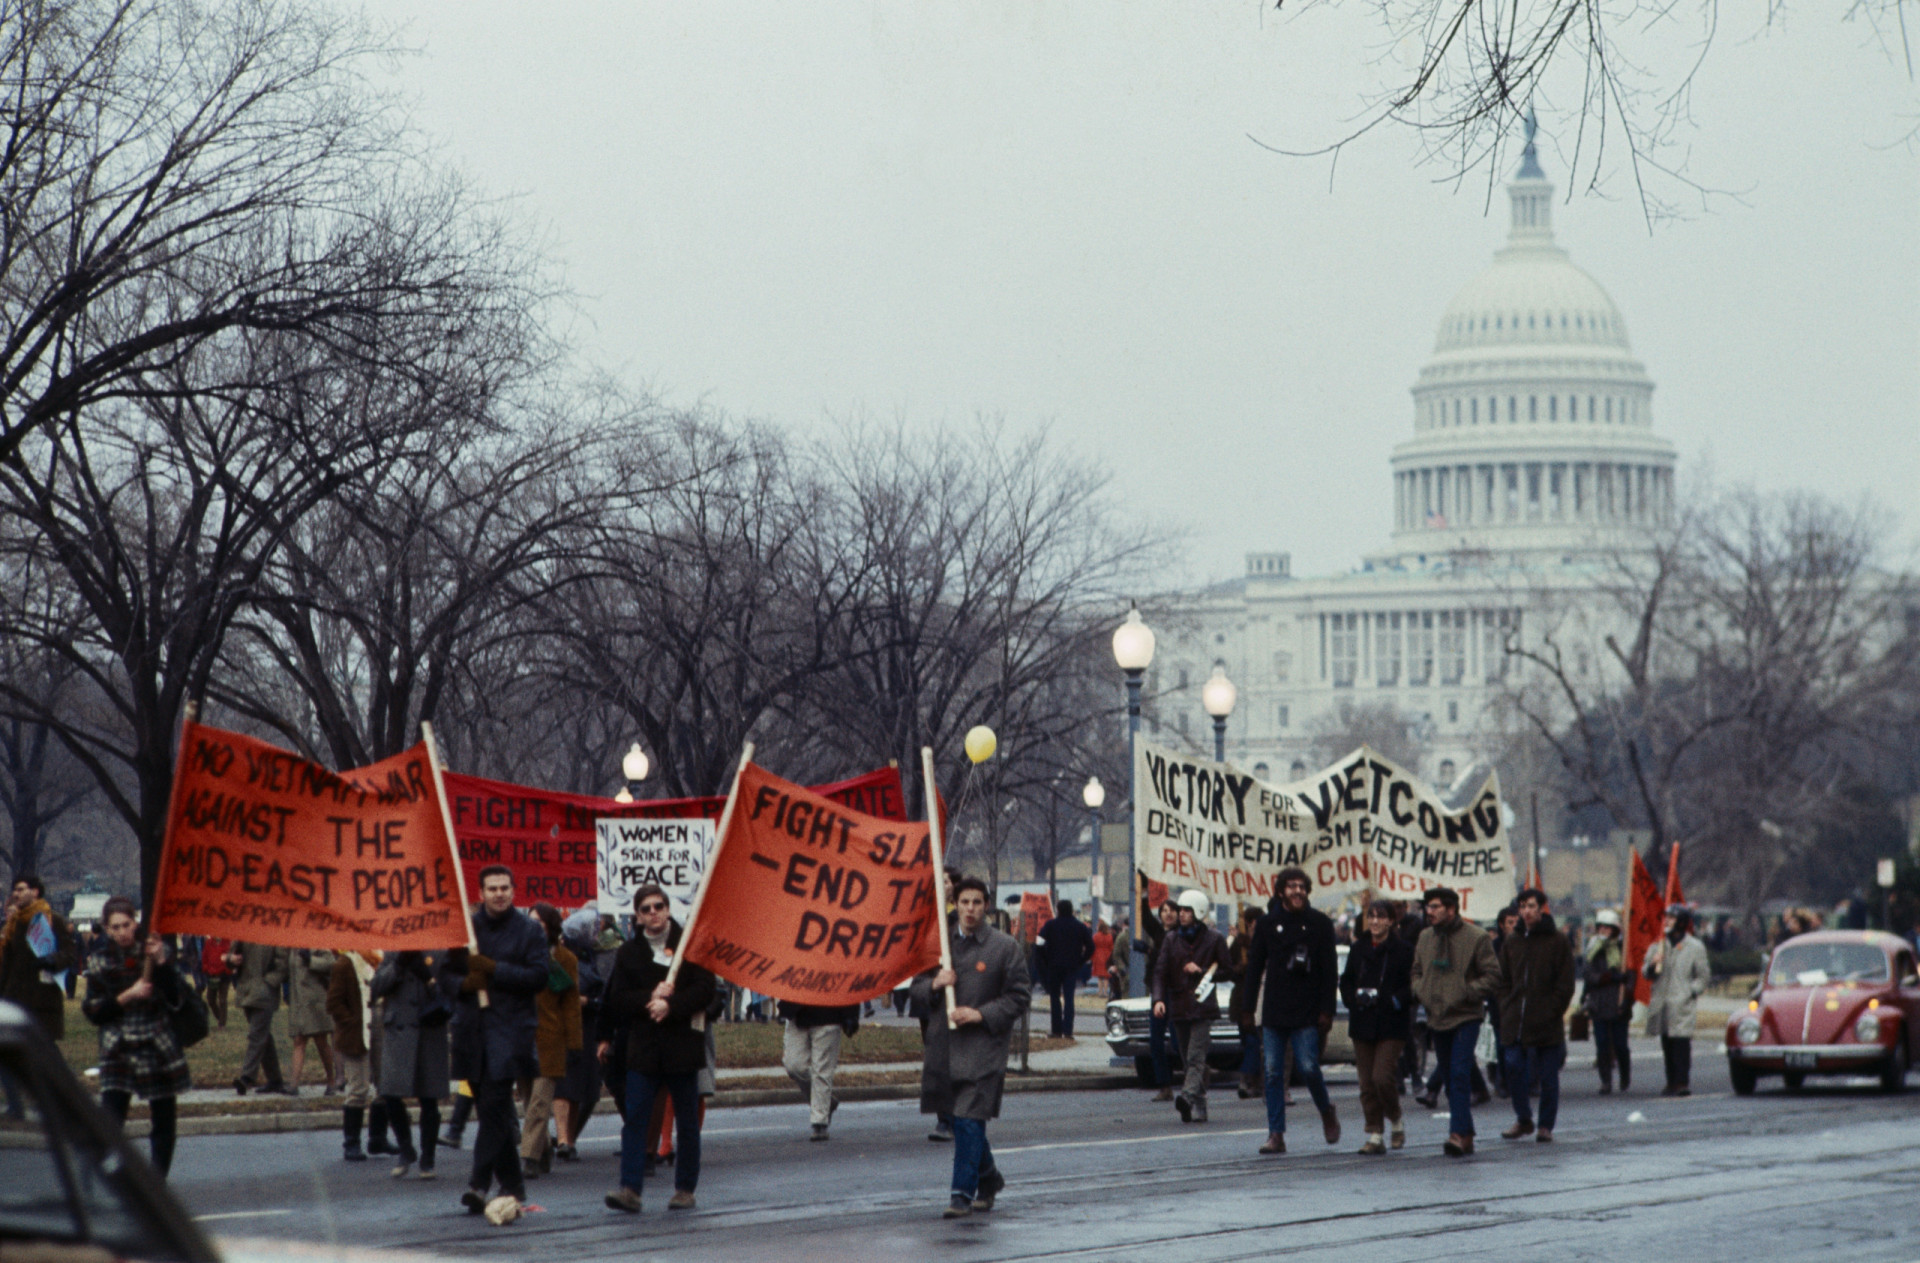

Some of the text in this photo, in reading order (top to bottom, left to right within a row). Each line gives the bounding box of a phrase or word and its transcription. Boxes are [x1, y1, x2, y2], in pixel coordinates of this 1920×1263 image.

[195, 739, 234, 778] NO
[368, 760, 428, 806] WAR
[1146, 750, 1254, 825] VICTORY
[184, 789, 407, 859] AGAINST THE
[456, 796, 548, 829] FIGHT
[833, 785, 897, 816] TATE
[1261, 790, 1296, 811] FOR
[1262, 810, 1300, 832] THE
[459, 839, 500, 860] ARM
[509, 840, 549, 863] THE
[619, 825, 688, 843] WOMEN
[751, 785, 932, 870] FIGHT SLA
[1360, 818, 1504, 877] EVERYWHERE
[174, 846, 448, 910] MID-EAST PEOPLE
[621, 849, 690, 862] STRIKE FOR
[621, 865, 690, 886] PEACE
[527, 876, 597, 900] REVOL
[1317, 853, 1473, 911] CONINGET
[707, 936, 774, 979] YOUTH
[771, 965, 849, 993] AGAINST
